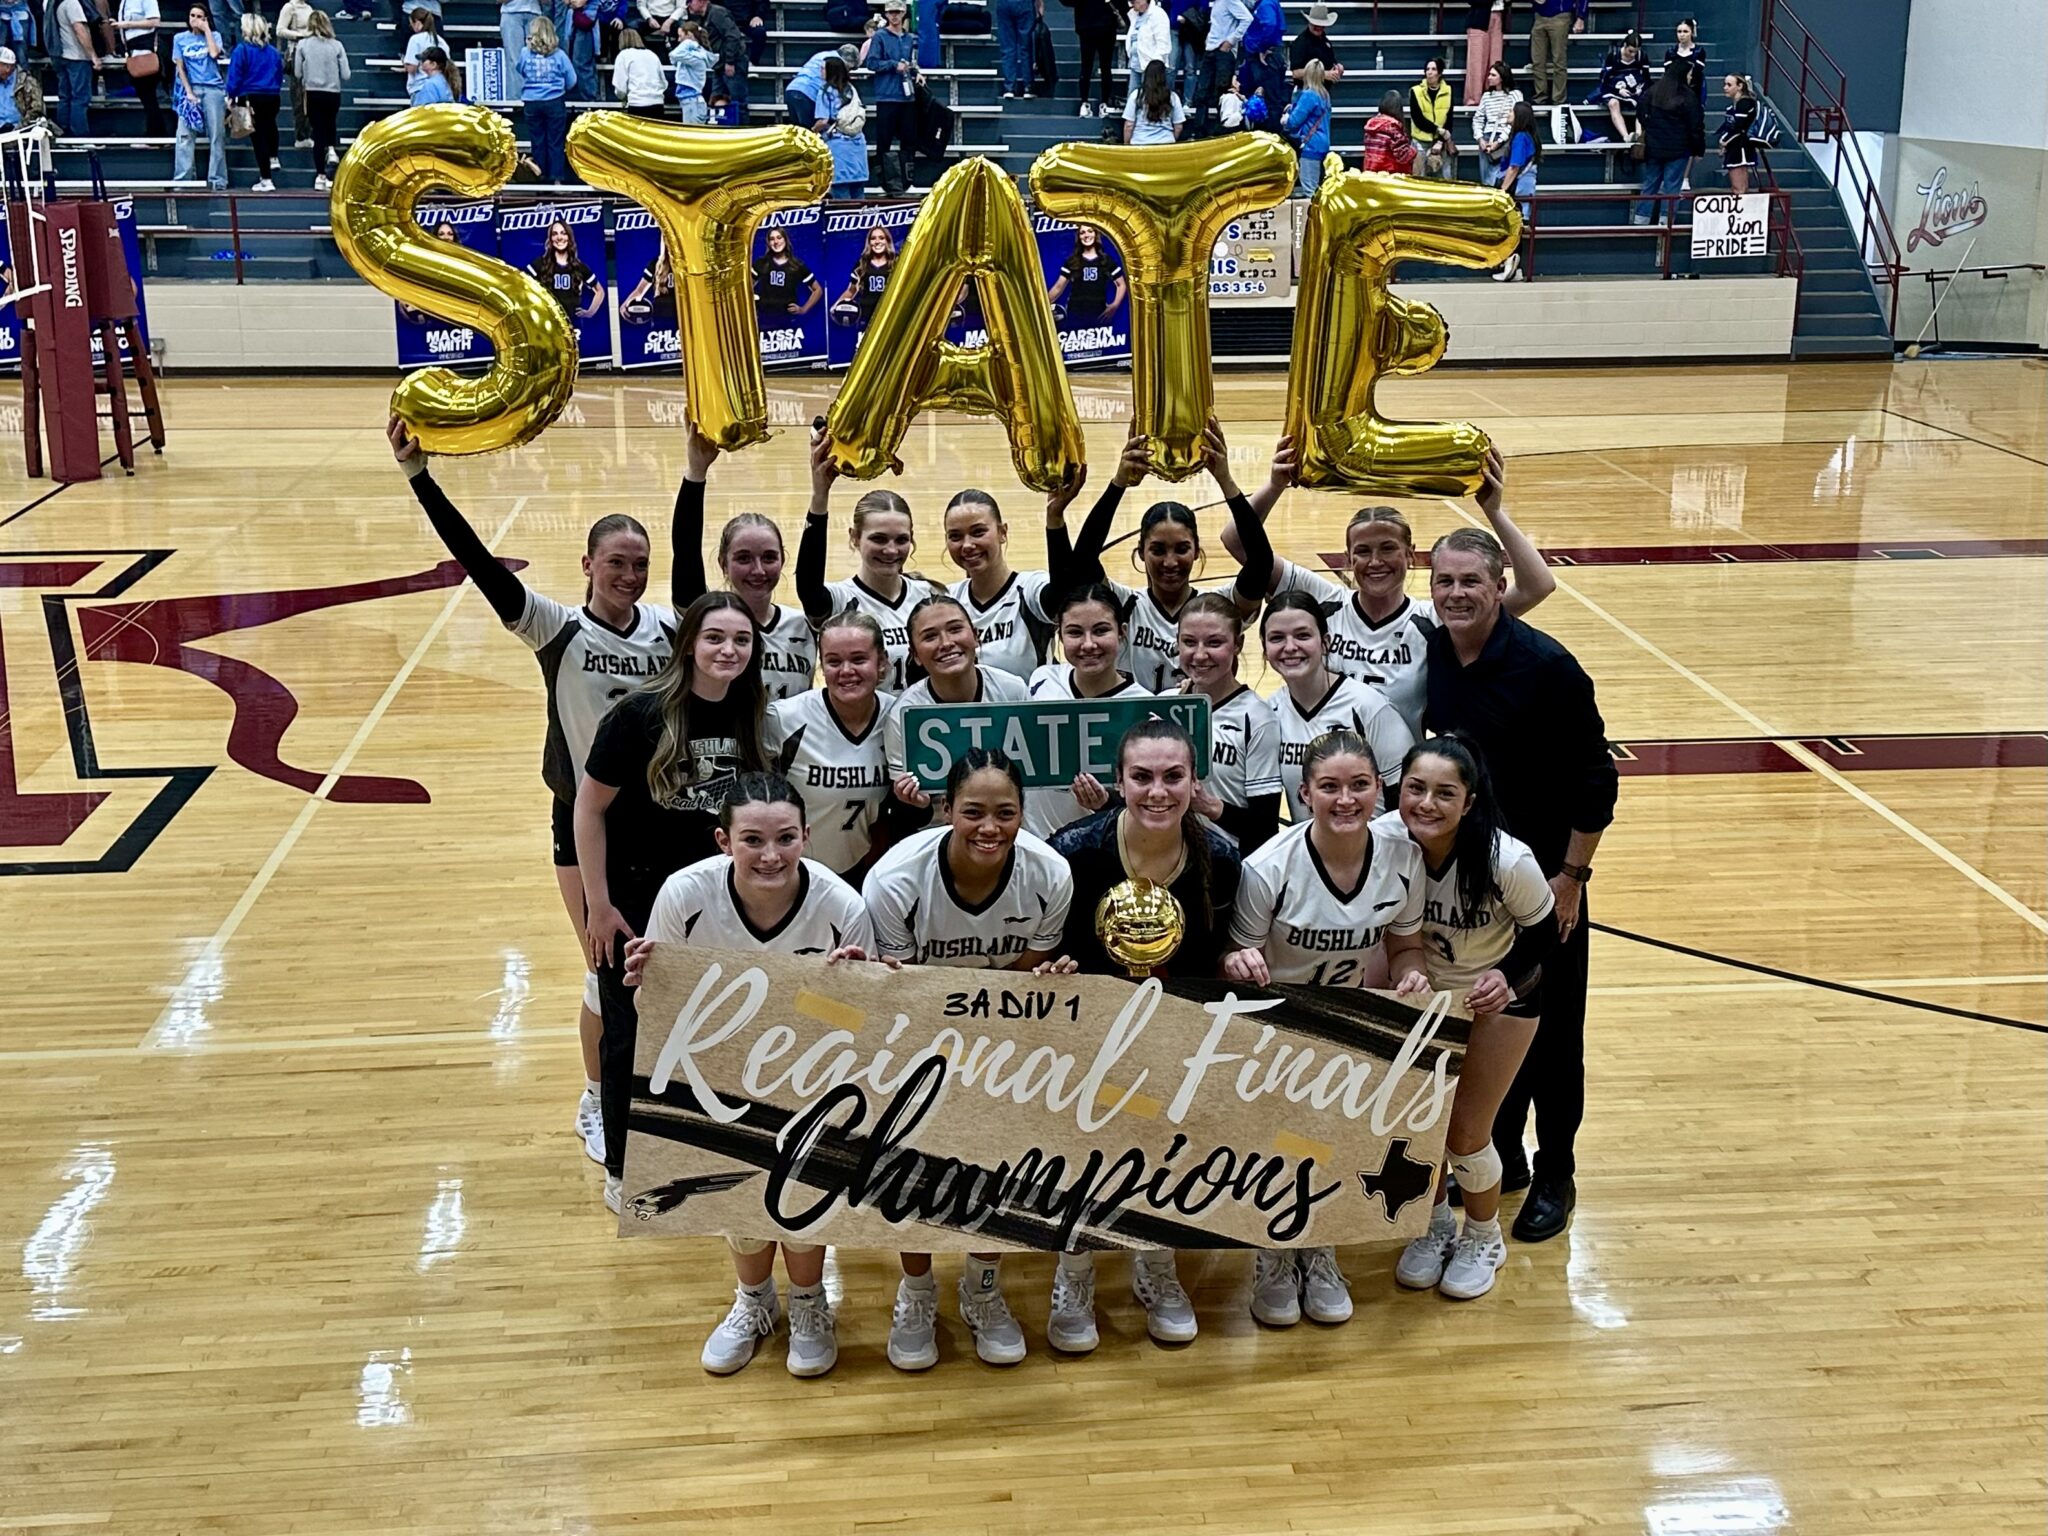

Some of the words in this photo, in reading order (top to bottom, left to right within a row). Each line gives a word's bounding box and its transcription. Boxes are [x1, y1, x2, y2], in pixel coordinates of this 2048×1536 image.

[414, 206, 494, 227] OUNDS
[502, 206, 602, 231] HOUNDS
[757, 207, 821, 229] UNDS
[826, 207, 919, 232] HOUNDS
[1907, 166, 1987, 252] Lions
[1726, 214, 1764, 235] lion
[1707, 237, 1748, 256] PRIDE
[59, 228, 83, 308] SPALDING
[770, 271, 785, 286] 12
[1083, 267, 1097, 280] 15
[554, 274, 571, 289] 10
[868, 276, 885, 292] 13
[332, 103, 1522, 497] STATE
[426, 328, 473, 344] MACIE
[647, 329, 681, 343] CHL
[760, 327, 804, 343] LYSSA
[1057, 326, 1113, 343] CARSYN
[428, 339, 471, 354] SMITH
[644, 340, 682, 354] PILGR
[760, 339, 802, 353] EDINA
[583, 649, 671, 675] BUSHLAN
[917, 712, 1112, 780] STATE
[1170, 704, 1198, 735] ST
[842, 799, 866, 831] 7
[1286, 925, 1385, 952] BUSHLAN
[1308, 958, 1358, 986] 12
[943, 988, 990, 1019] 3A
[1065, 994, 1080, 1021] 1
[649, 962, 1163, 1153] Regional
[1167, 990, 1460, 1136] Finals
[764, 1054, 1342, 1251] Champions
